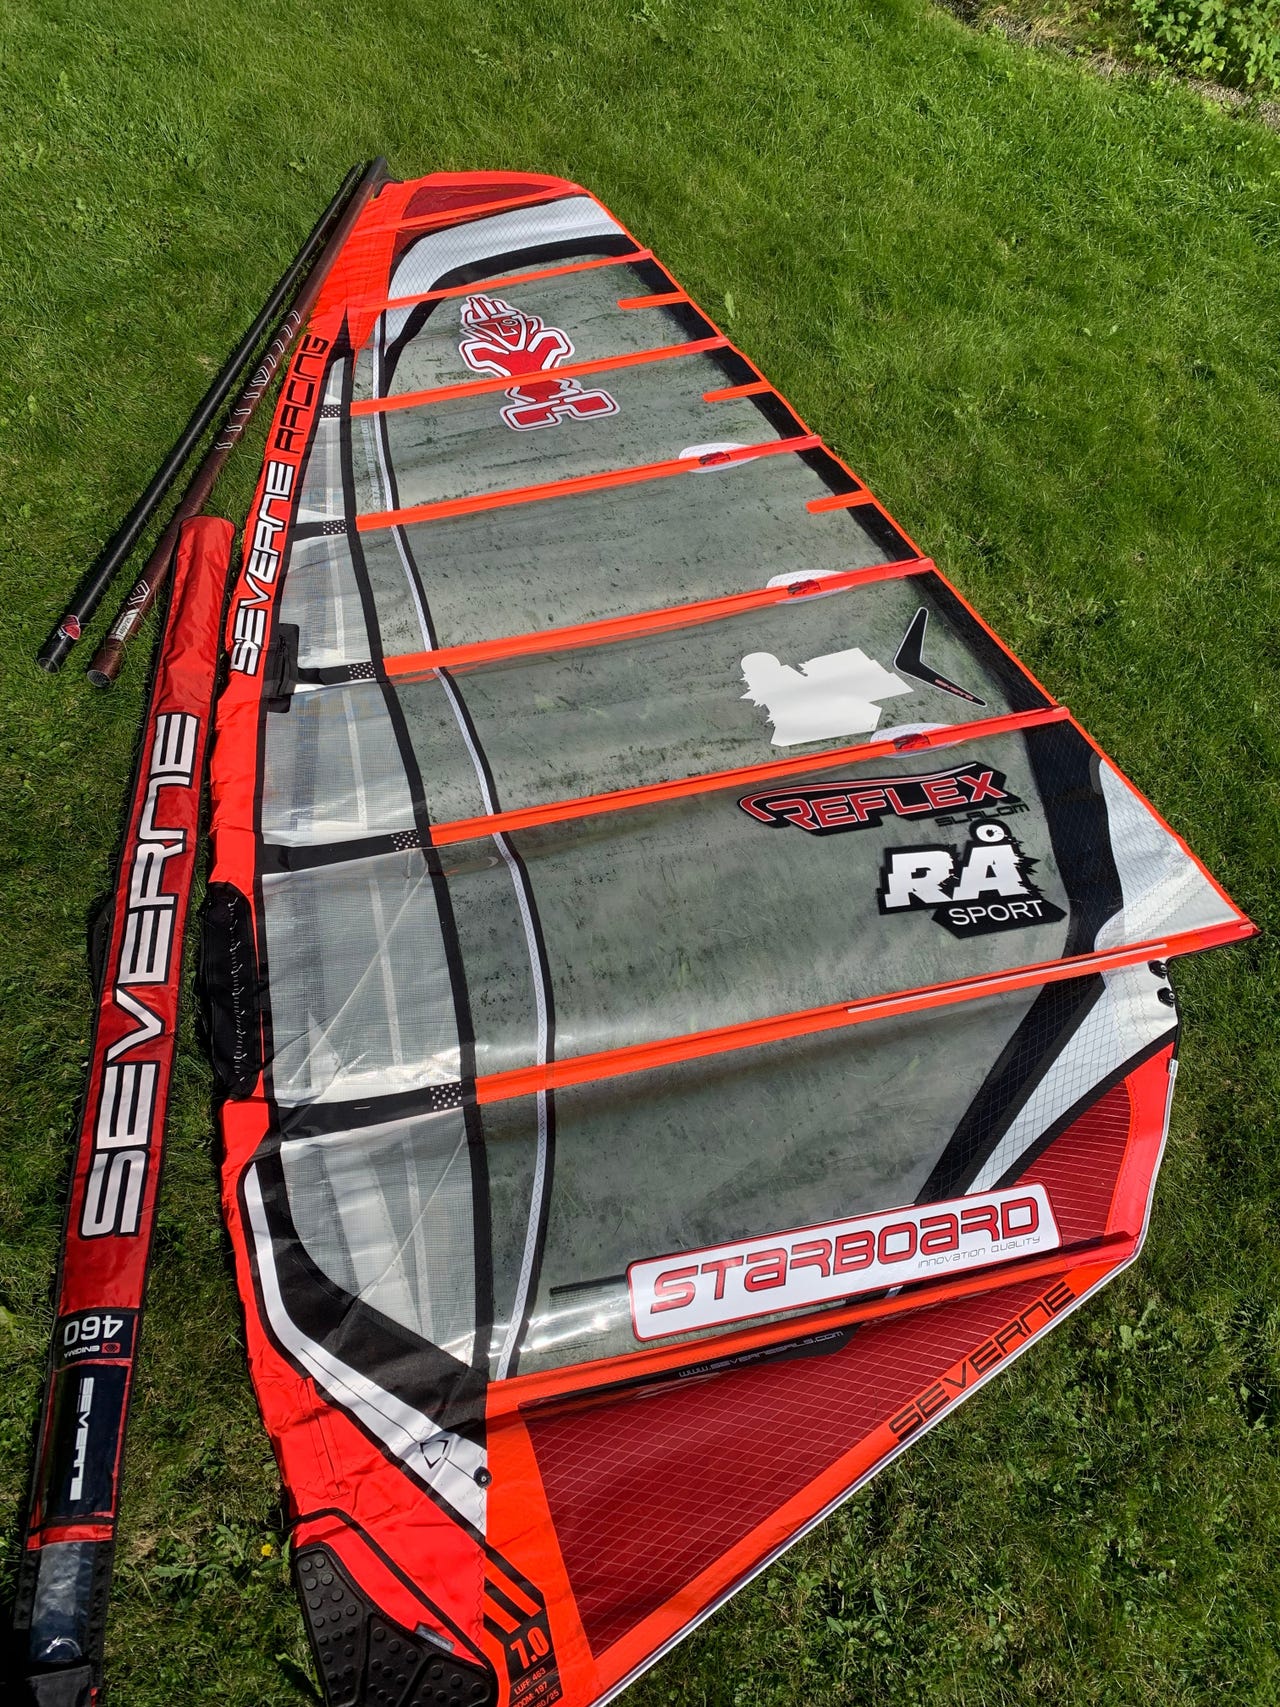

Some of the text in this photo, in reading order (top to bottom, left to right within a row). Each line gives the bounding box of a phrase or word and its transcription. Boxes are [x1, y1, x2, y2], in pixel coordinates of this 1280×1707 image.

[229, 333, 331, 676] SEVERNE RACING
[740, 764, 1007, 830] REFLEX
[935, 801, 1030, 827] SLALOM
[949, 900, 1043, 926] SPORT
[78, 713, 198, 1238] SEVERNE
[649, 1196, 1040, 1316] STARBOARD
[63, 1314, 124, 1346] 460
[63, 1345, 100, 1359] ENIGMA
[888, 1280, 1077, 1441] SEVERNE
[69, 1376, 95, 1501] SEVERNE
[509, 1626, 550, 1669] 7.0
[532, 1667, 546, 1681] 463
[534, 1681, 548, 1695] 197
